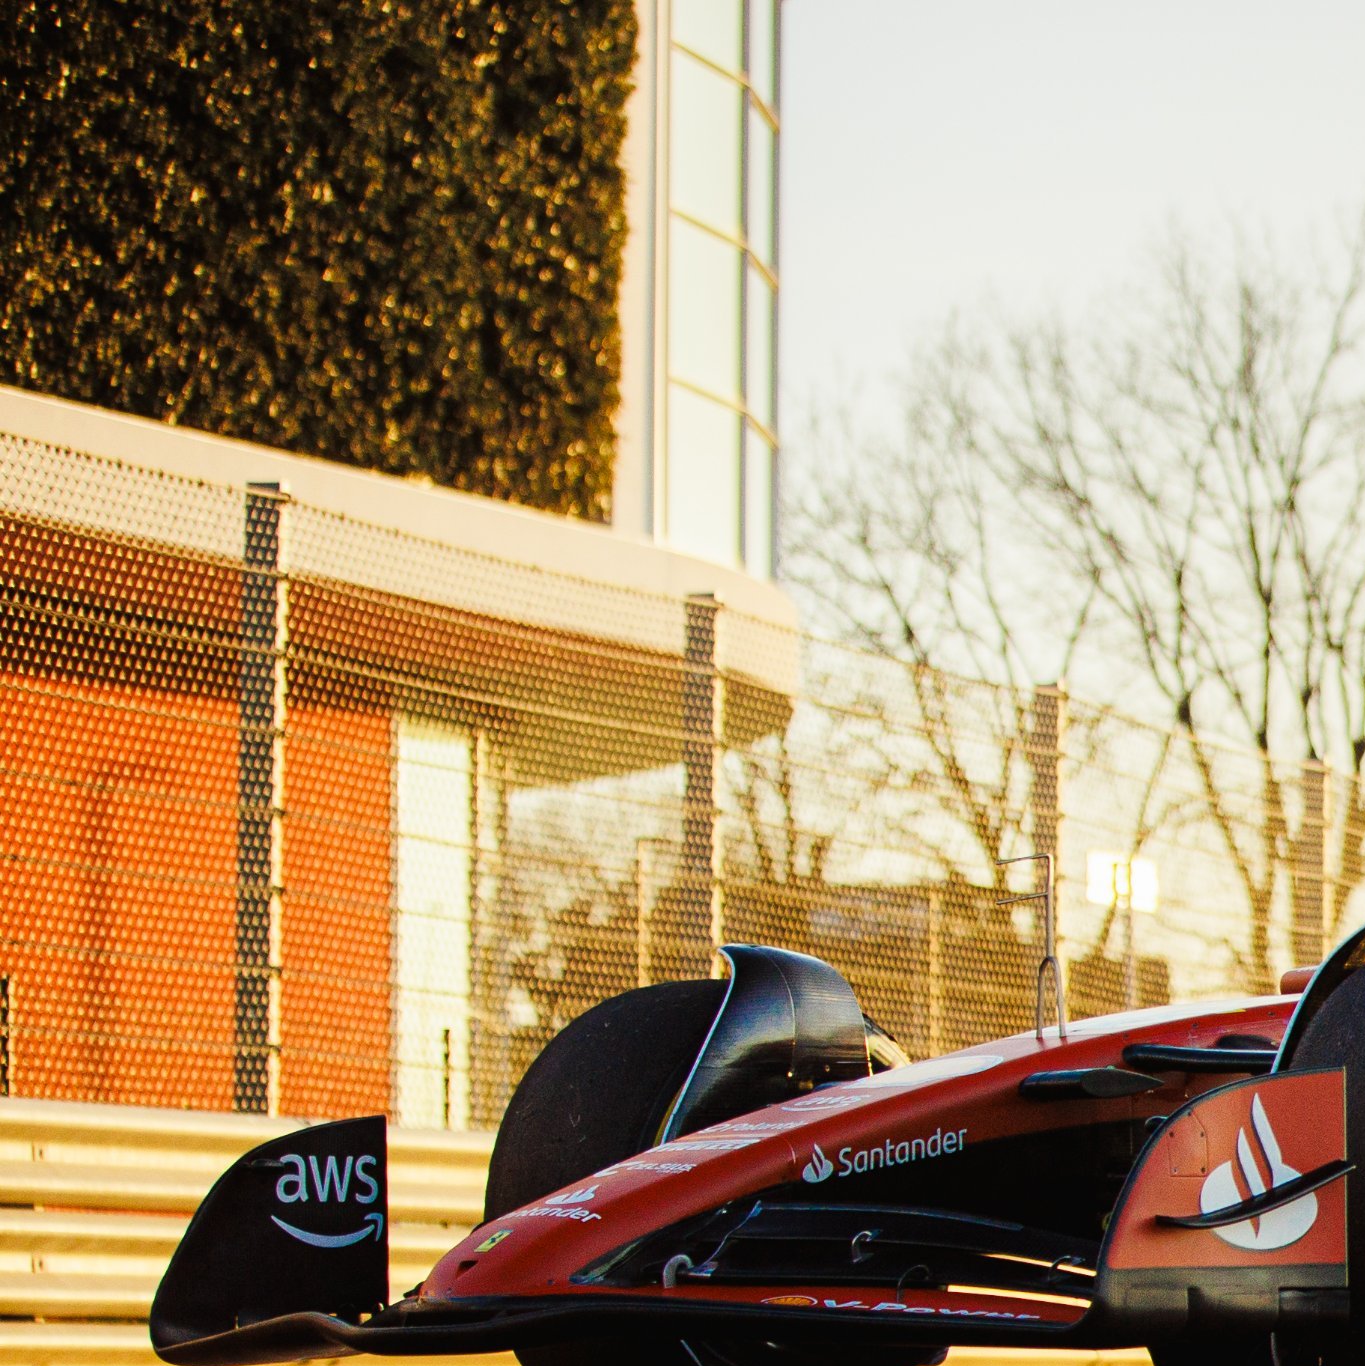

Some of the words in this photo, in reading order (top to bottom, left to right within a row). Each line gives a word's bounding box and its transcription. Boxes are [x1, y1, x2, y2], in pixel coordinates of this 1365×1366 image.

[838, 1128, 967, 1177] Santander
[276, 1154, 378, 1204] aws
[497, 1207, 602, 1222] ntander
